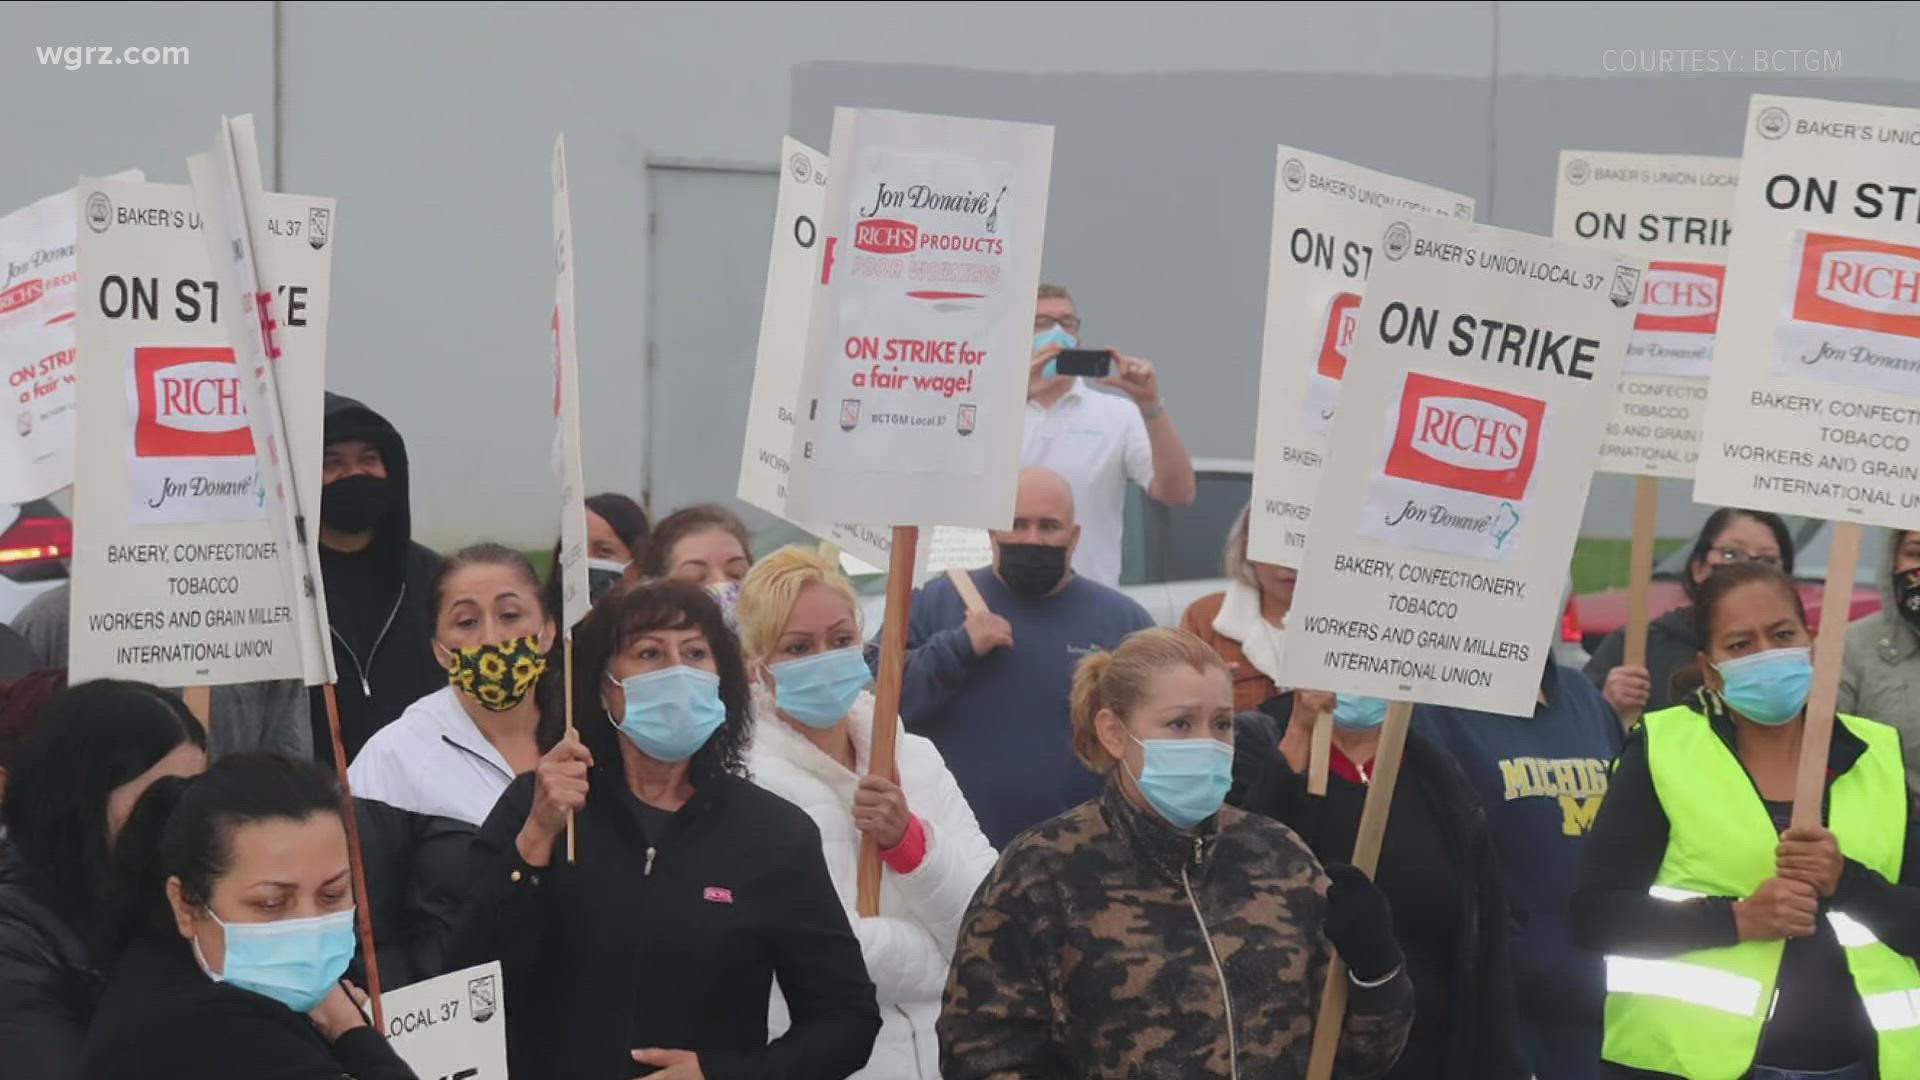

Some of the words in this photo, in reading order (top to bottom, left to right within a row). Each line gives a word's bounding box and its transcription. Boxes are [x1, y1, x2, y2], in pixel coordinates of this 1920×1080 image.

[1796, 119, 1873, 140] BAKER'S
[1654, 170, 1697, 185] UNION
[860, 183, 905, 218] Jon
[1765, 174, 1838, 214] ON
[1854, 182, 1920, 224] ST
[117, 207, 184, 229] BAKER'S
[286, 221, 301, 237] 37
[1575, 211, 1626, 239] ON
[857, 225, 915, 249] RICH'S
[920, 233, 1004, 256] PRODUCTS
[1291, 228, 1334, 271] ON
[1414, 238, 1476, 267] BAKER'S
[1479, 254, 1527, 277] UNION
[1529, 262, 1579, 288] LOCAL
[1582, 273, 1604, 291] 37
[100, 275, 158, 320] ON
[1641, 280, 1714, 308] ICH'S
[845, 336, 880, 360] ON
[883, 338, 957, 365] STRIKE
[959, 341, 987, 366] for
[1380, 301, 1440, 350] ON
[1448, 313, 1600, 381] STRIKE
[1801, 341, 1847, 365] Jon
[160, 377, 247, 417] RICH
[852, 373, 866, 388] a
[870, 366, 909, 389] fair
[913, 370, 974, 398] wage!
[1624, 403, 1690, 420] TOBACCO
[1752, 391, 1823, 415] BAKERY,
[911, 415, 935, 426] Local
[1420, 404, 1522, 461] RICH'S
[1624, 425, 1651, 439] AND
[1654, 427, 1697, 442] GRAIN
[1821, 427, 1910, 452] TOBACCO
[1723, 443, 1814, 467] WORKERS
[1817, 455, 1857, 473] AND
[1862, 460, 1918, 481] GRAIN
[1753, 474, 1896, 506] INTERNATIONAL
[1384, 500, 1427, 526] Jon
[108, 544, 168, 564] BAKERY,
[168, 577, 239, 596] TOBACCO
[1334, 555, 1396, 582] BAKERY,
[1399, 562, 1527, 599] CONFECTIONERY,
[89, 611, 165, 632] WORKERS
[169, 613, 200, 630] AND
[205, 608, 246, 628] GRAIN
[249, 606, 293, 626] MILLER
[1389, 595, 1458, 619] TOBACCO
[117, 643, 231, 665] INTERNATIONAL
[234, 639, 273, 660] UNION
[1304, 615, 1379, 642] WORKERS
[1381, 626, 1415, 646] AND
[1417, 630, 1462, 652] GRAIN
[1463, 636, 1530, 662] MILLERS
[1324, 650, 1438, 681] INTERNATIONAL
[1441, 666, 1493, 688] UNION
[1499, 757, 1609, 801] MICHIG
[440, 1001, 460, 1021] 37
